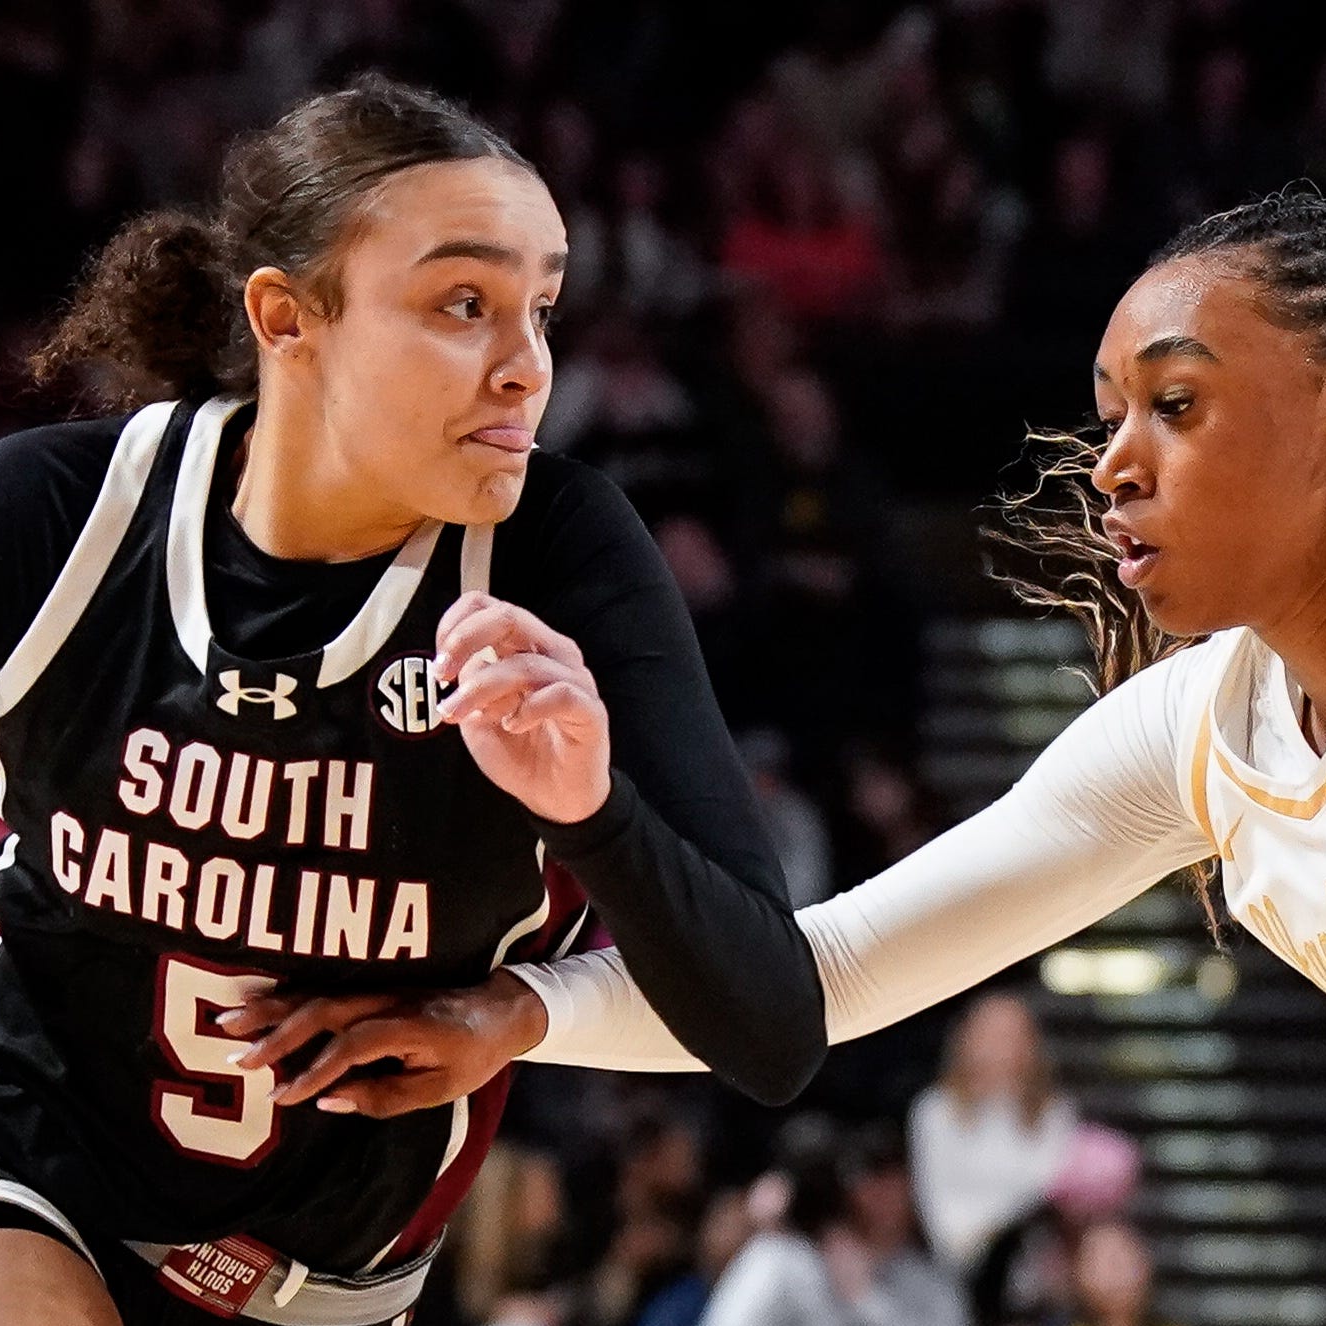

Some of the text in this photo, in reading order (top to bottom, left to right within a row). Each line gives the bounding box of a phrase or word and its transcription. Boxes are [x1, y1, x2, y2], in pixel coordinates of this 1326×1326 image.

[118, 727, 374, 850] SOUTH
[50, 811, 431, 961] CAROLINA
[157, 955, 280, 1166] 5
[187, 1260, 235, 1294] SOUTH
